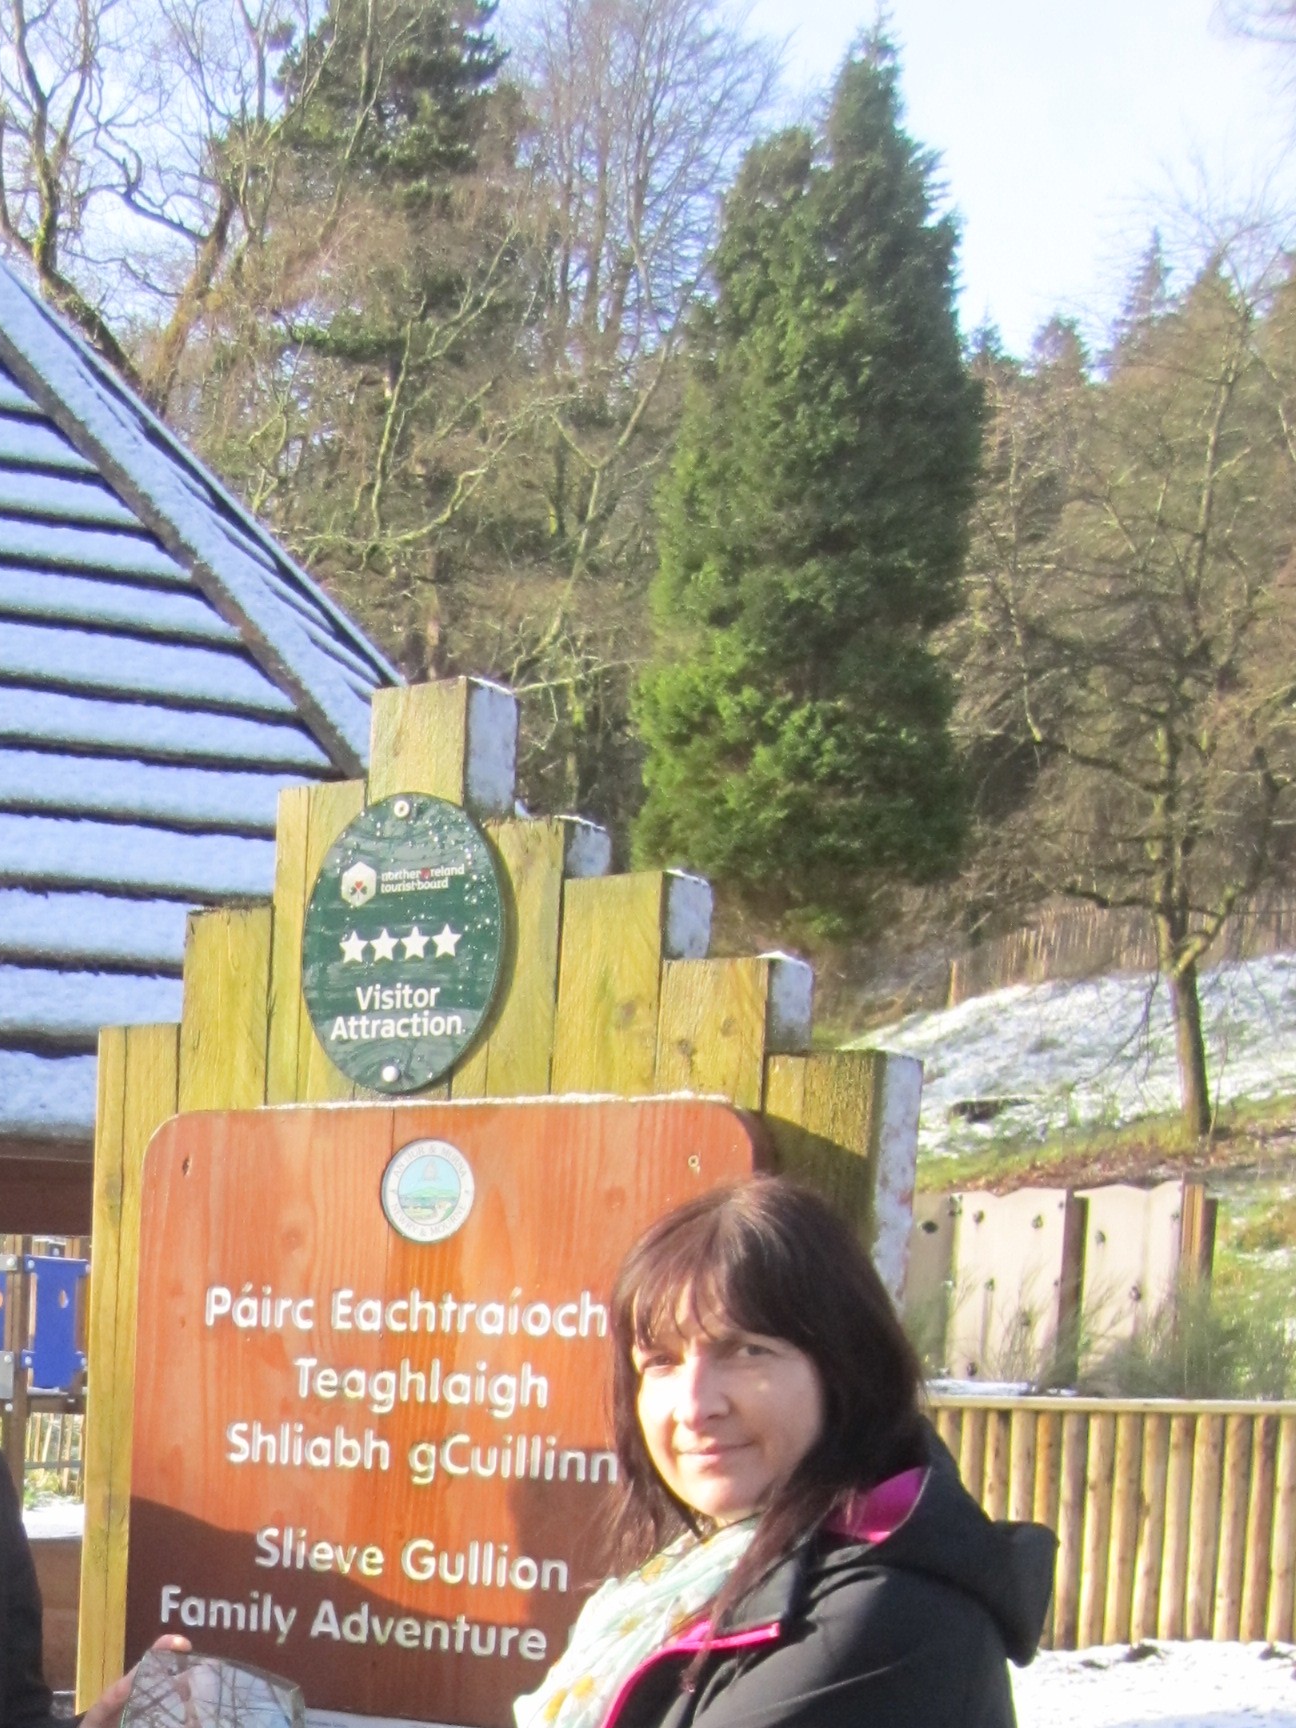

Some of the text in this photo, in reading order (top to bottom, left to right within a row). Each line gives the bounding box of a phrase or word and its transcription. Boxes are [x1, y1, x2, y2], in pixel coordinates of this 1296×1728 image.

[330, 1012, 462, 1041] Attraction
[356, 983, 441, 1012] Visitor
[205, 1281, 608, 1338] Páirc Eachtraíoch
[294, 1358, 549, 1419] Teaghlaigh
[226, 1420, 618, 1485] Shliabh gCuillinn
[255, 1526, 569, 1593] Slieve Gullion
[161, 1584, 297, 1646] Family
[309, 1599, 547, 1661] Adventure
